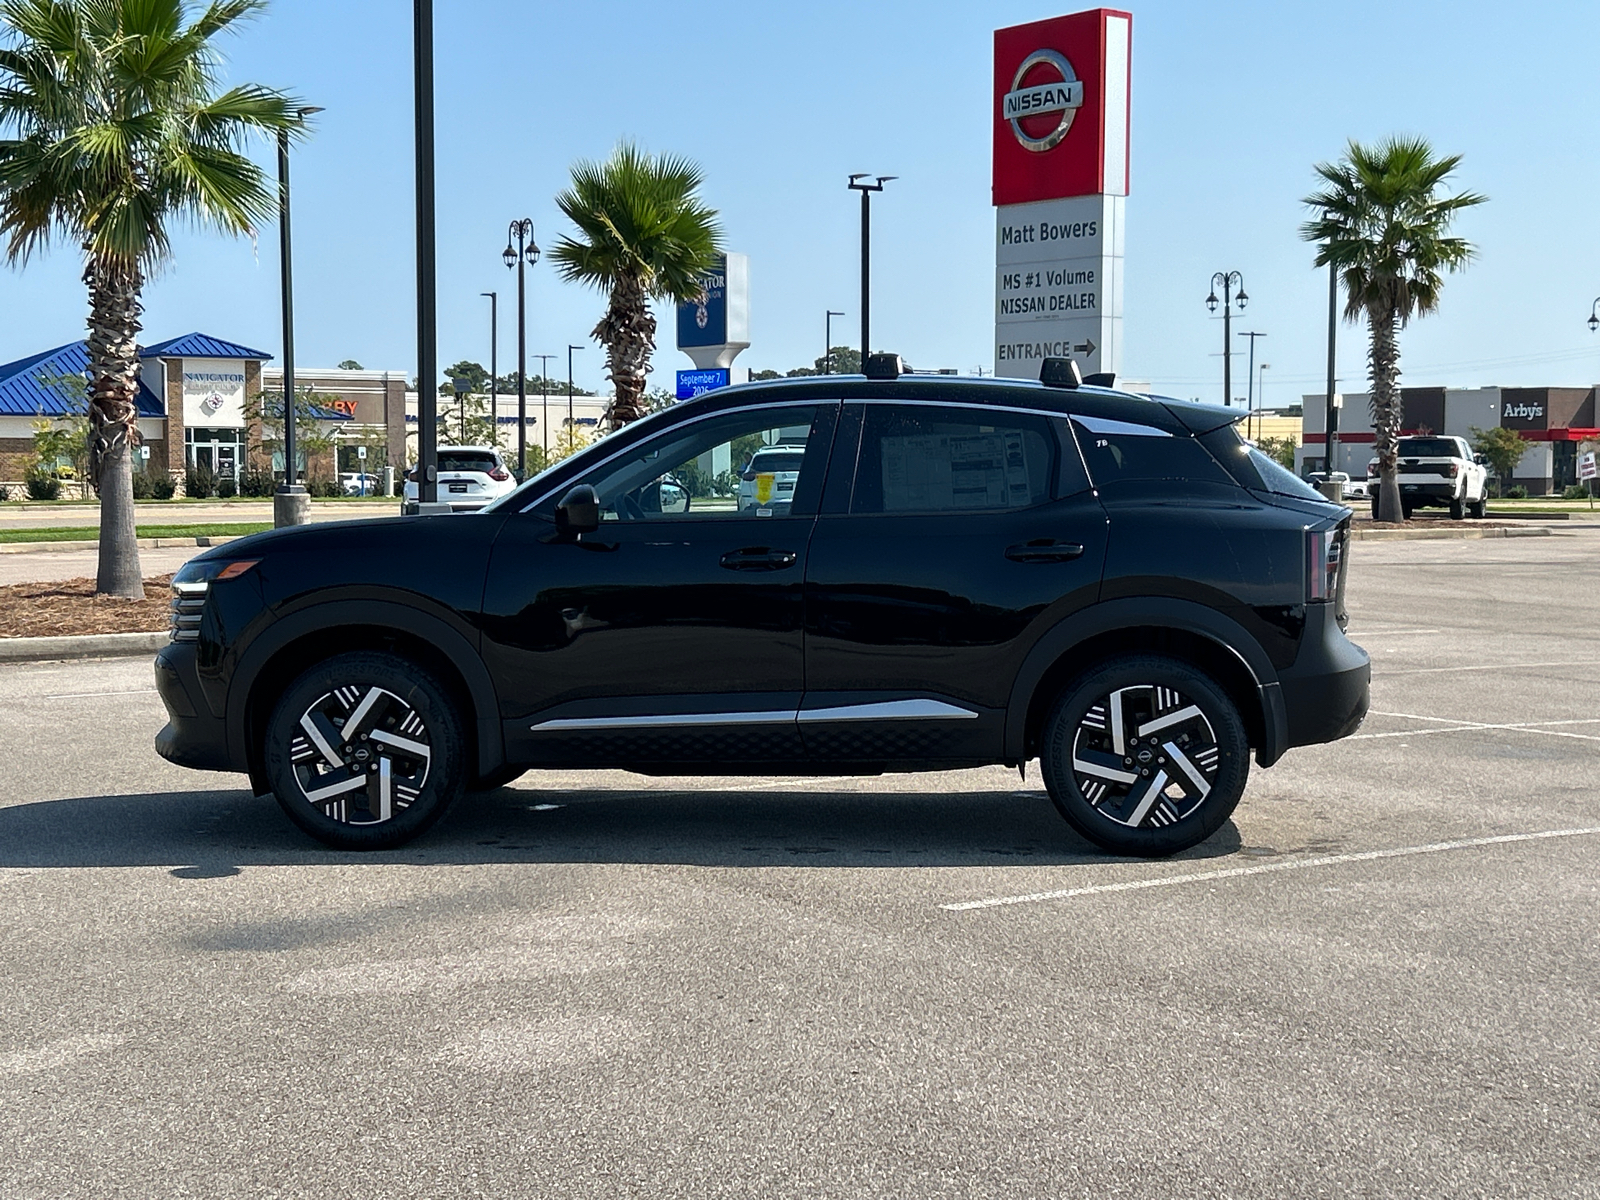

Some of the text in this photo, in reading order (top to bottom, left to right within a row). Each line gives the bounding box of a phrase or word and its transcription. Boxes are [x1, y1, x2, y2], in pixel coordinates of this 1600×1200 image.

[1008, 88, 1072, 114] NISSAN
[1002, 221, 1097, 245] Matt Bowers
[1003, 269, 1095, 290] MS #1 Volume
[1001, 293, 1096, 315] NISSAN DEALER
[999, 341, 1070, 360] ENTRANCE
[184, 373, 245, 382] NAVIGATOR
[680, 373, 715, 387] September
[1503, 402, 1543, 421] Arby's
[1052, 715, 1073, 799] BRIDGESTONE
